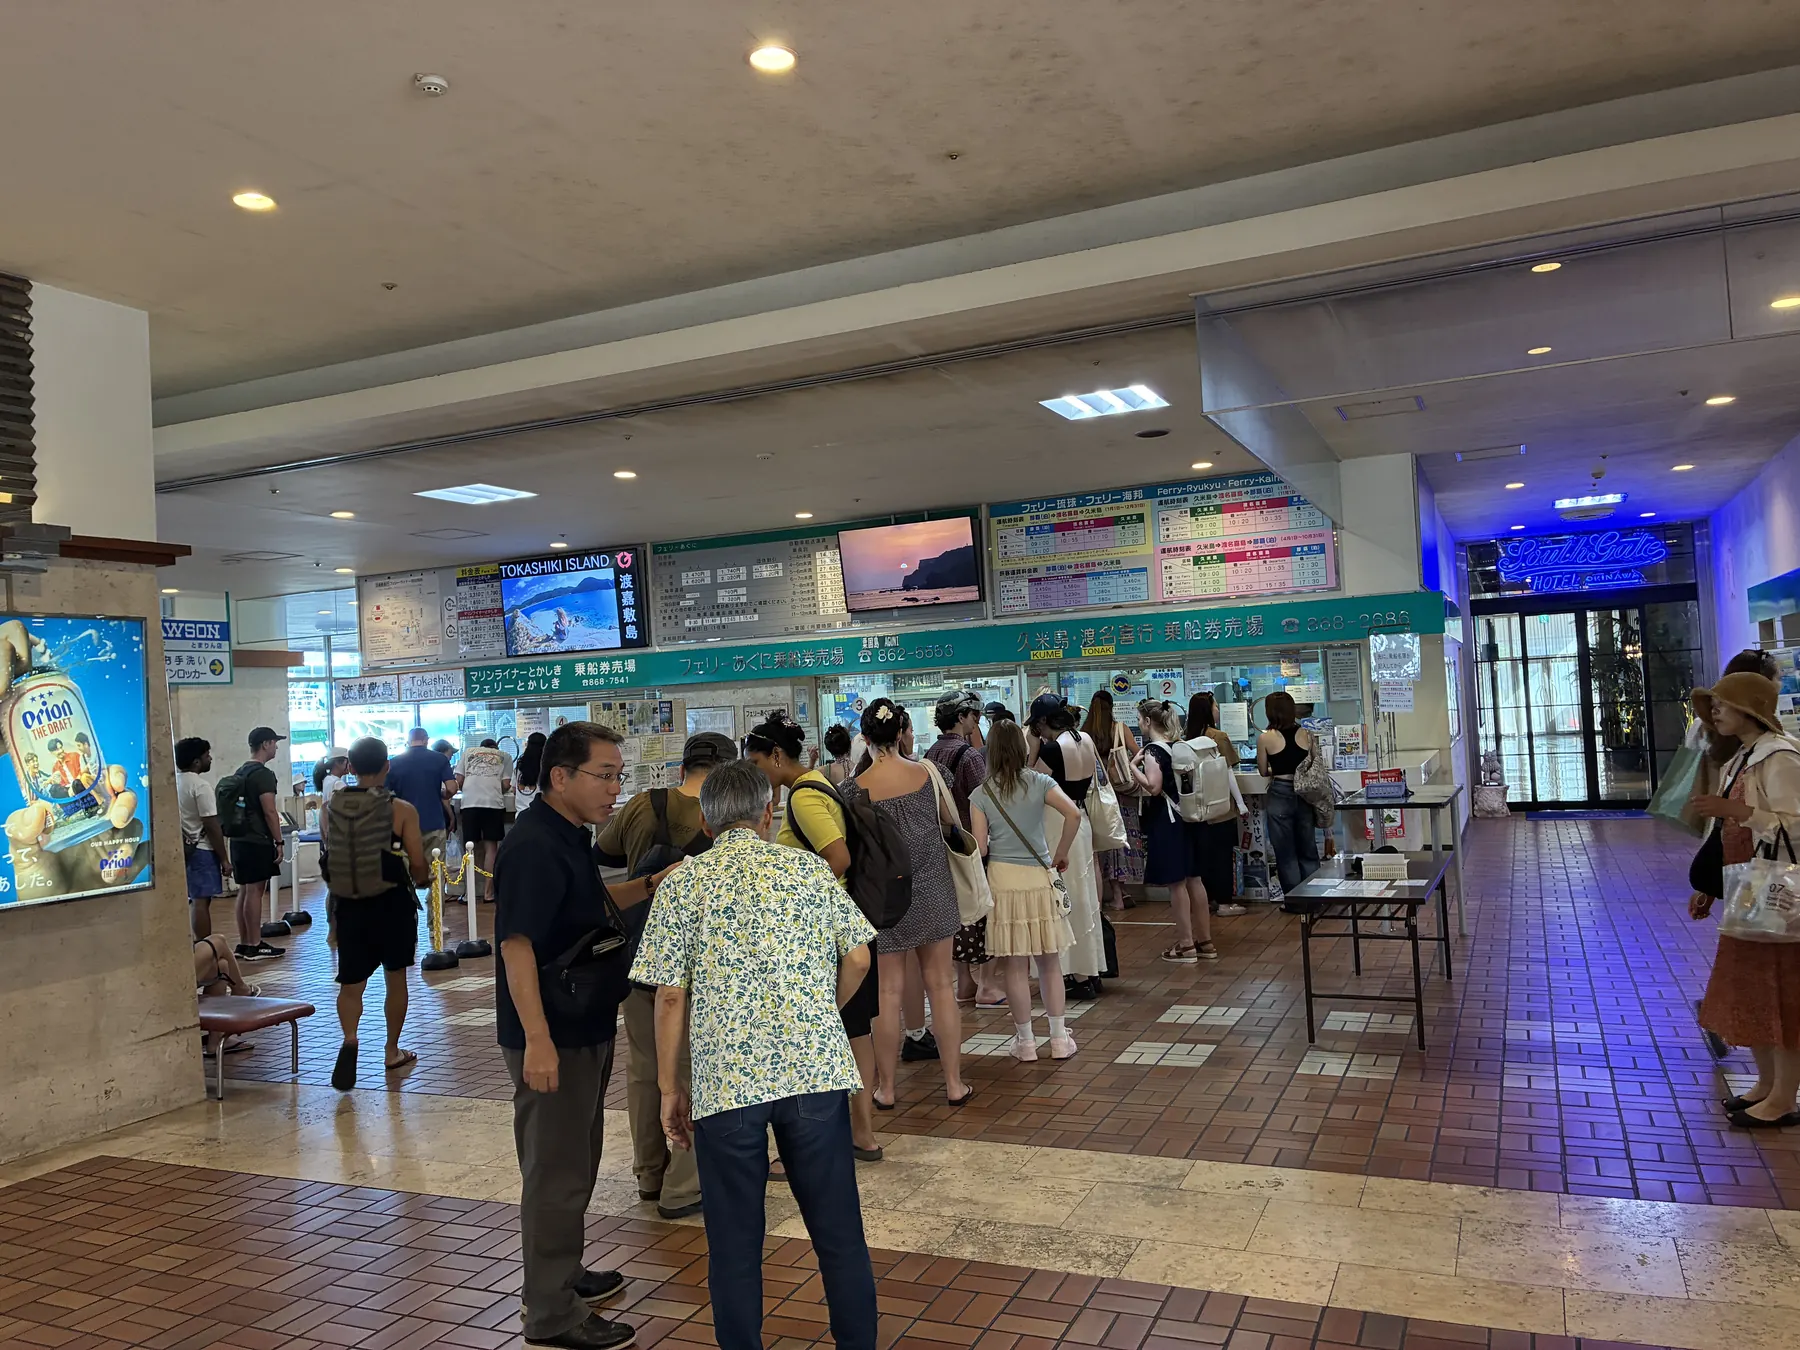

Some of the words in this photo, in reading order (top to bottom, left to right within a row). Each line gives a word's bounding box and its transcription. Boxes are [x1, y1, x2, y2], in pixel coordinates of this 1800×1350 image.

[1157, 482, 1220, 496] Ferry-Ryukyu
[1196, 543, 1215, 551] 久米島
[461, 567, 480, 576] 料金表
[500, 560, 562, 578] TOKASHIKI
[565, 554, 610, 571] ISLAND
[1232, 567, 1252, 575] 10:20
[1533, 574, 1580, 590] HOTEL
[1585, 570, 1640, 583] OKINAWA
[619, 573, 638, 640] 渡嘉敷島
[878, 644, 954, 663] 862-5553
[1031, 650, 1062, 660] KUME
[1082, 646, 1114, 655] TONAKI
[679, 647, 844, 676] フェリーあくに乗船券売場
[469, 665, 562, 681] マリンライナーとかしき
[574, 659, 637, 677] 乗船券売場
[410, 672, 455, 687] Tokashiki
[471, 678, 560, 695] フェリーとかしき
[403, 687, 433, 699] Ticket
[436, 685, 465, 698] office
[1163, 681, 1172, 695] 2
[855, 699, 863, 711] 3
[22, 699, 74, 730] Orion
[558, 717, 564, 726] 4
[31, 724, 49, 741] THE
[48, 717, 74, 735] DRAFT
[104, 838, 124, 846] HAPPY
[100, 855, 133, 870] Orion
[1769, 882, 1785, 893] 07
